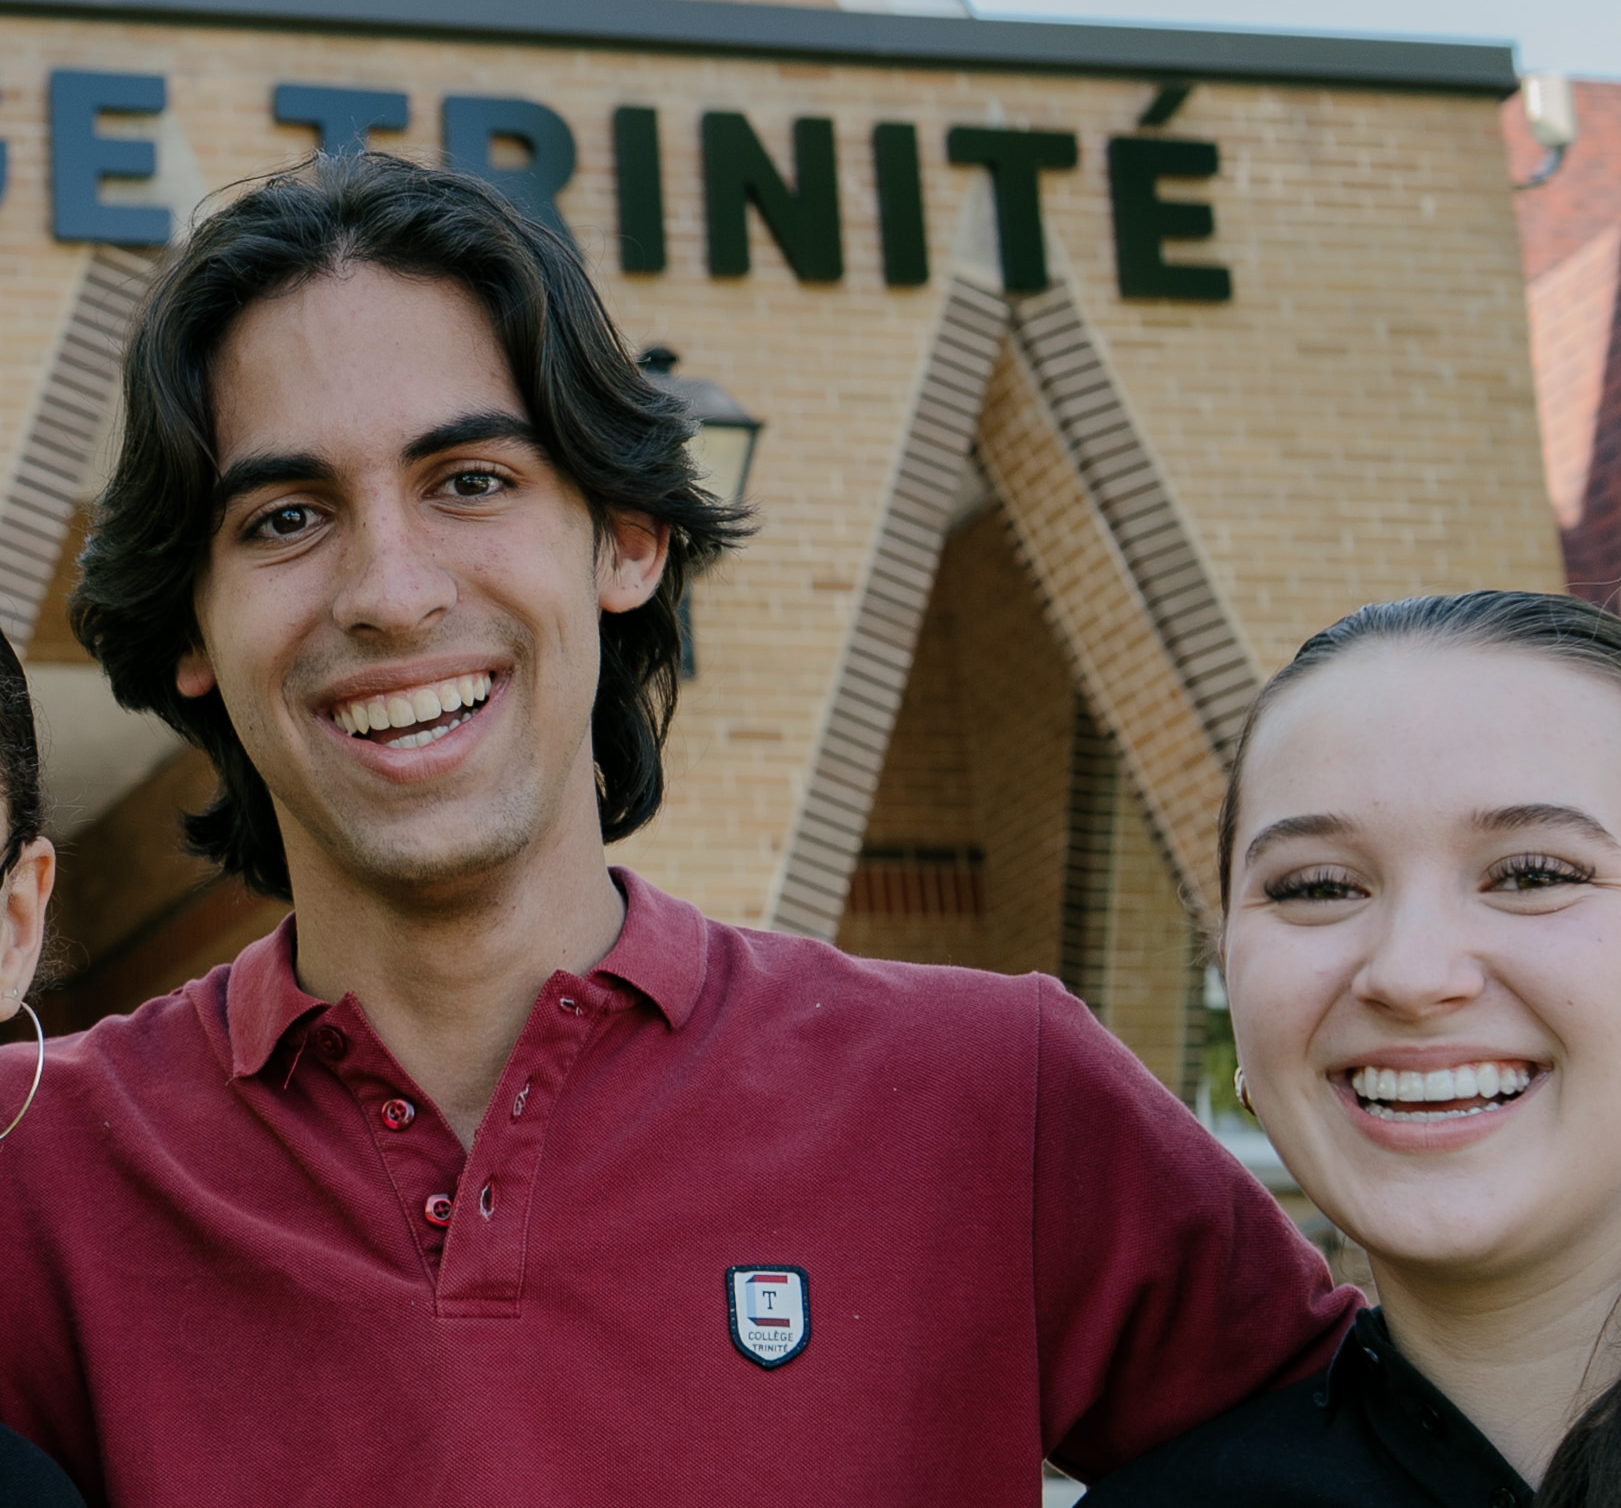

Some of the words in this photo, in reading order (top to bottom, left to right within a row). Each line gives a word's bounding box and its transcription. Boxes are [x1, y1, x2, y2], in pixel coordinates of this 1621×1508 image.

[763, 1290, 777, 1310] T
[748, 1330, 794, 1342] COLLÈGE
[752, 1343, 788, 1353] TRINITÉ
